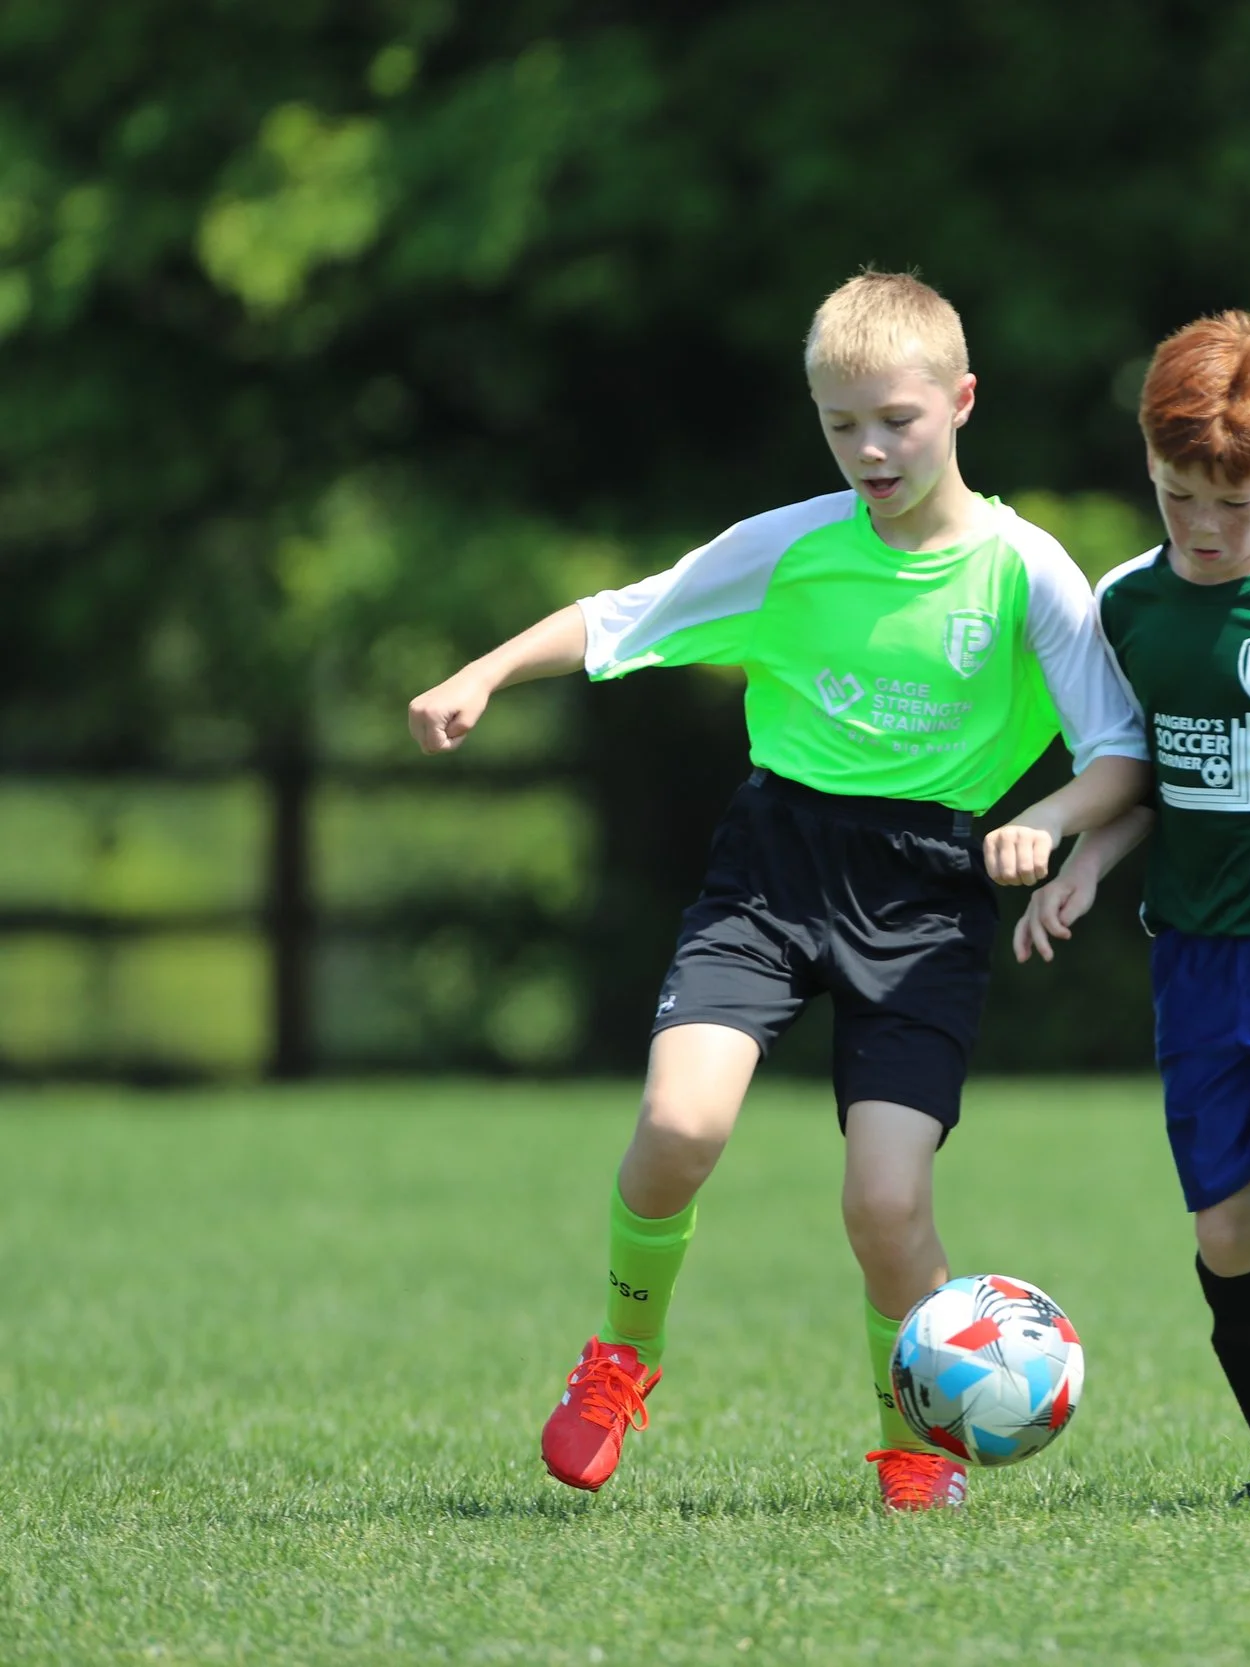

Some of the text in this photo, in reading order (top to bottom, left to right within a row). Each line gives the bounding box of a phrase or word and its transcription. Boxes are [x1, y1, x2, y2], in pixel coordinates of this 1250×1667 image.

[875, 677, 931, 698] GAGE
[872, 694, 973, 717] STRENGTH
[870, 710, 962, 732] TRAINING
[1154, 712, 1225, 732] ANGELO'S
[1155, 727, 1230, 755] SOCCER
